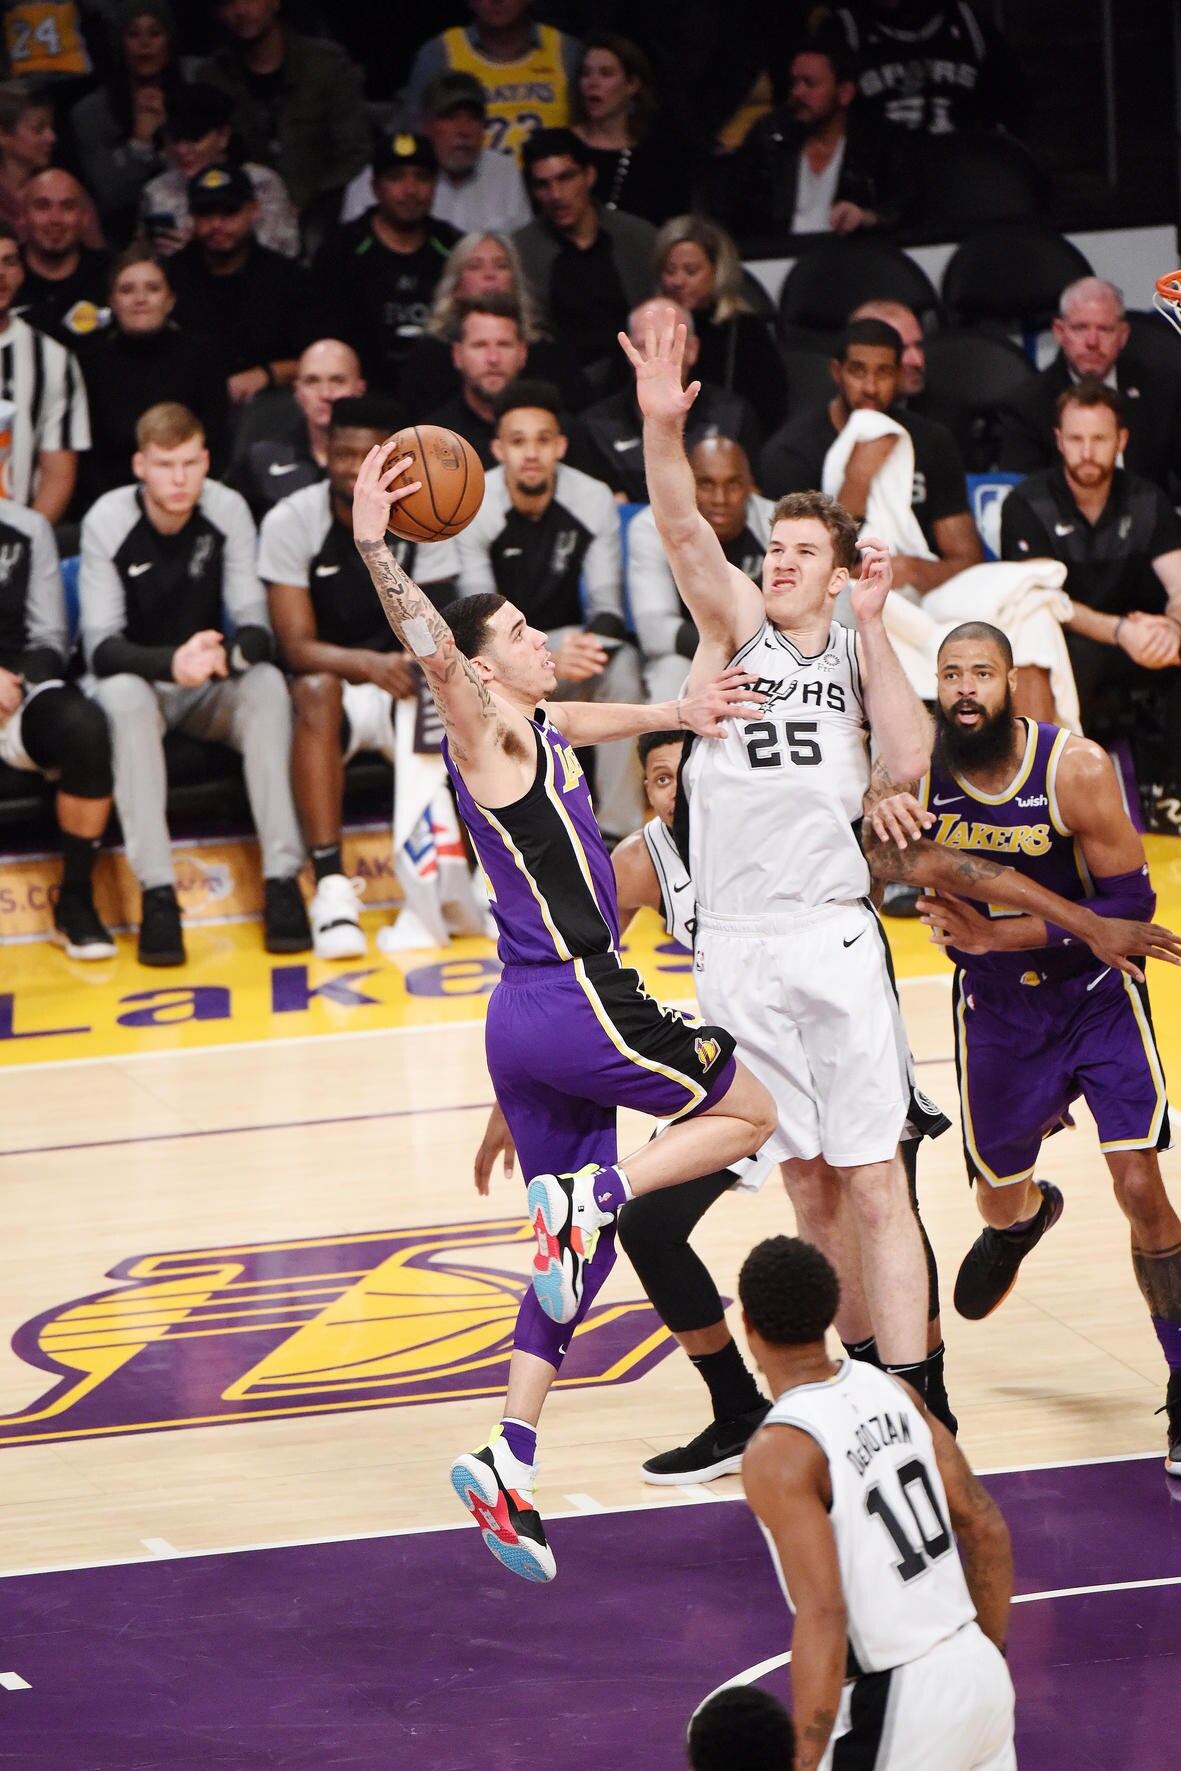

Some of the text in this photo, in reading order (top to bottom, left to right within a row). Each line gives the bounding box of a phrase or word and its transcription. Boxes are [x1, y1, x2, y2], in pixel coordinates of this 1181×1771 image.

[12, 16, 62, 60] 24
[737, 670, 846, 714] PURS
[743, 720, 825, 769] 25
[1014, 794, 1049, 808] wish
[934, 813, 1053, 857] LAKERS
[865, 1458, 951, 1582] 10
